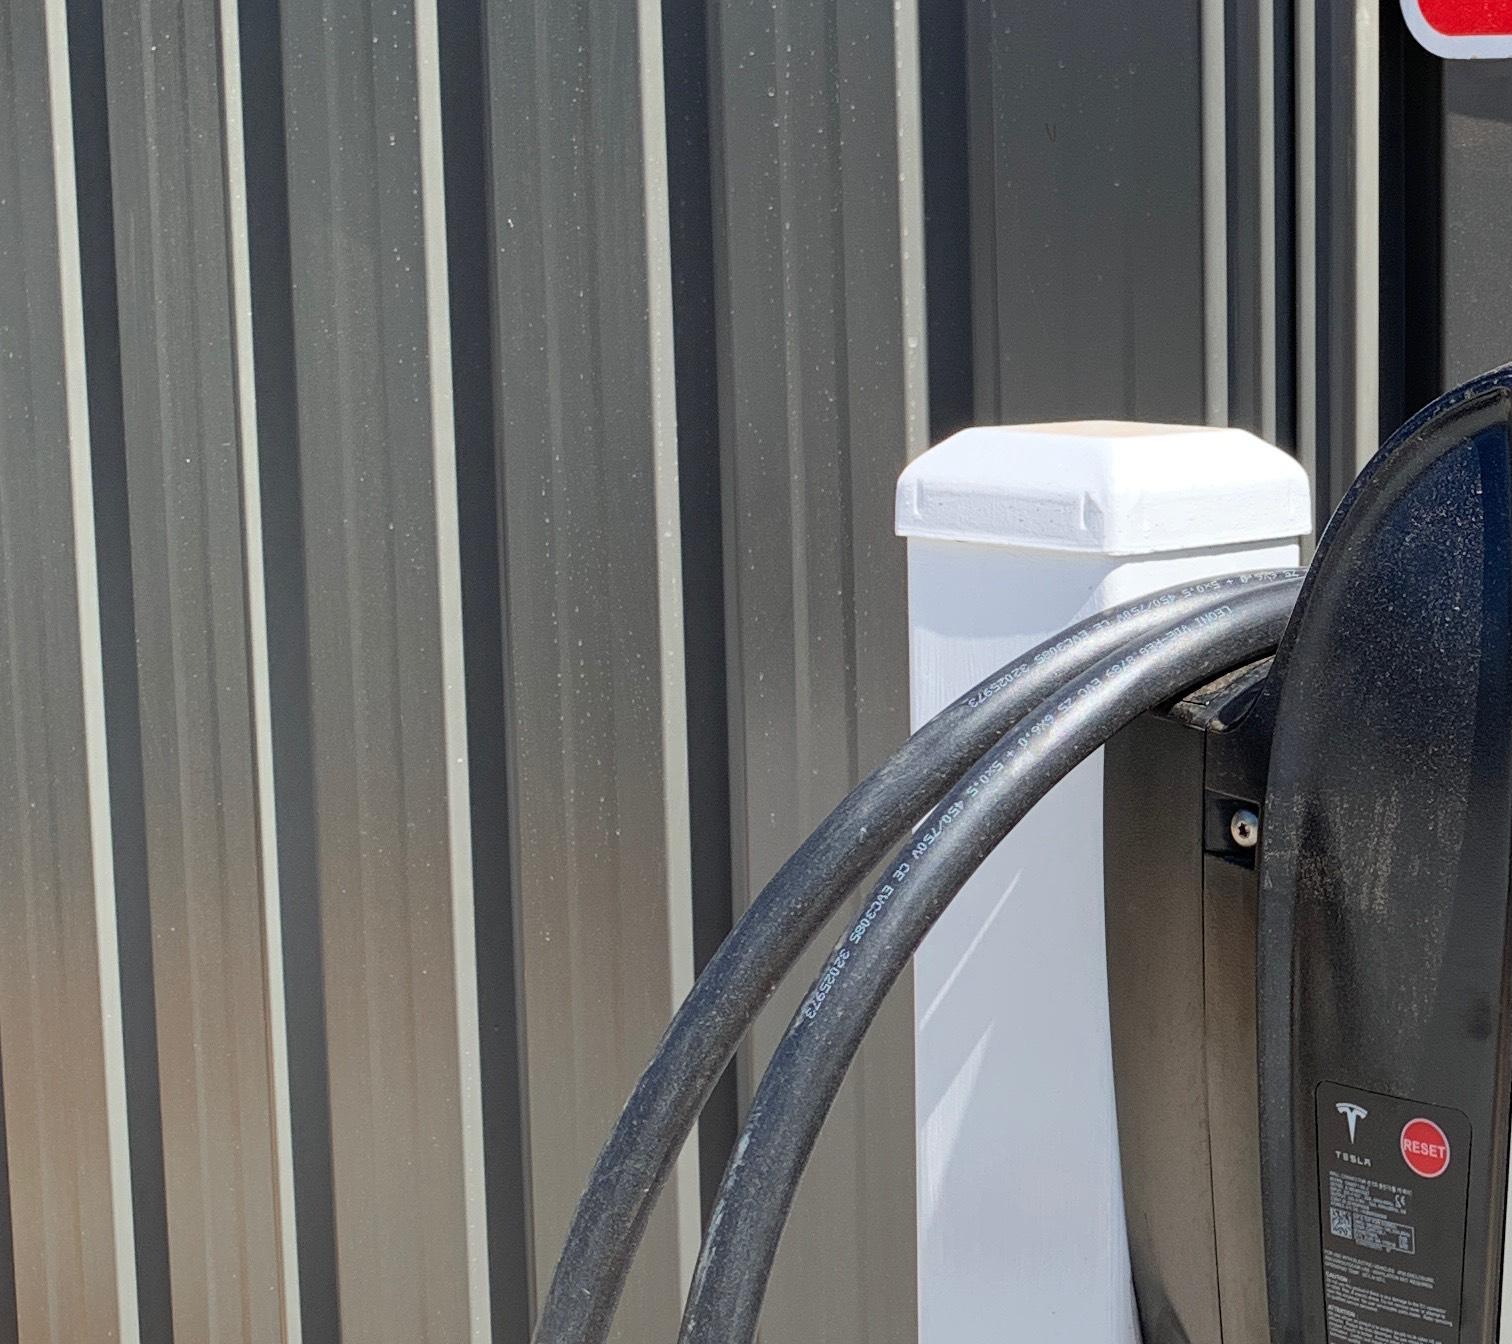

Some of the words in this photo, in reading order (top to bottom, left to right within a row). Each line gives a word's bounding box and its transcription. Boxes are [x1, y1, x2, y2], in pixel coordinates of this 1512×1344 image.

[1194, 605, 1233, 629] LEONI
[968, 663, 1030, 708] 32025973
[911, 800, 964, 860] 450/750V
[893, 862, 910, 882] CE
[850, 884, 894, 944] EVC3085
[805, 948, 850, 1019] 32025973
[1335, 1150, 1372, 1167] TESLA
[1403, 1138, 1446, 1159] RESET
